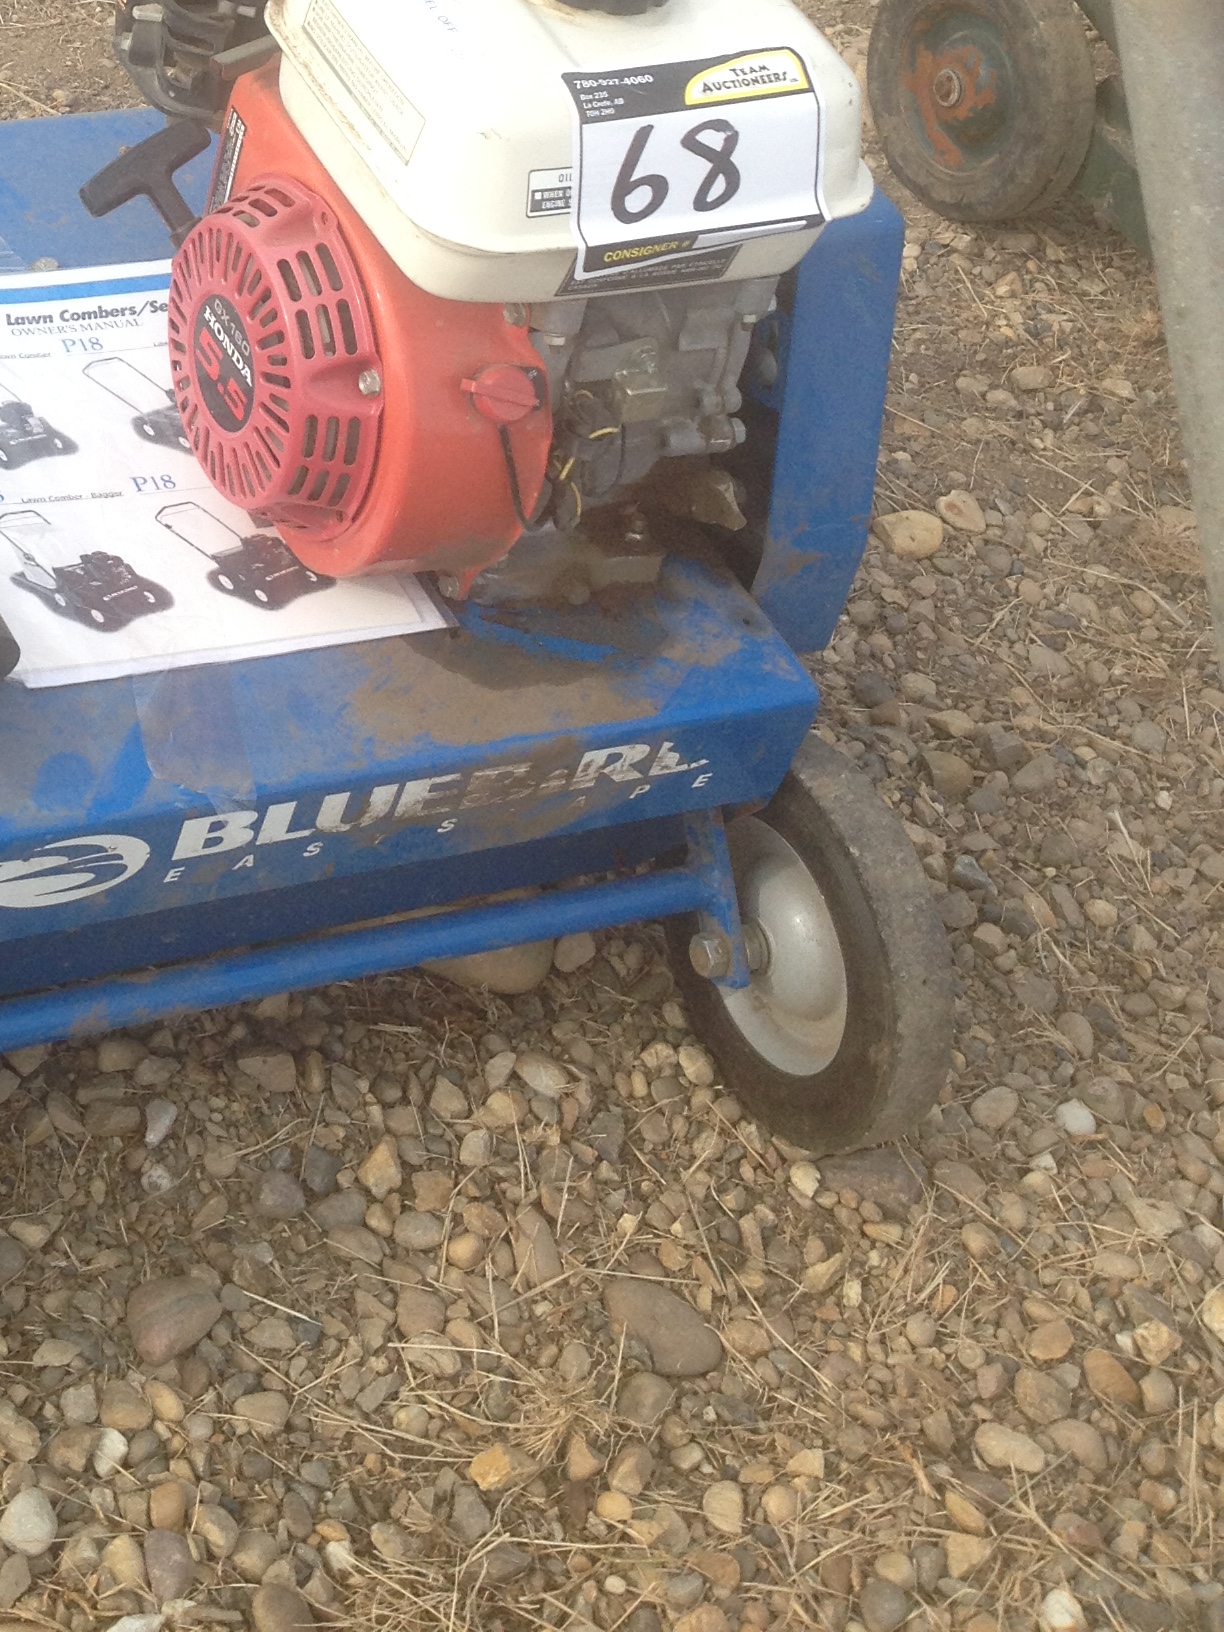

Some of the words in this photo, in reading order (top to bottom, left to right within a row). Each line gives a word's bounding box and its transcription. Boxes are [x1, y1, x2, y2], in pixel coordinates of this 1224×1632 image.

[729, 65, 770, 77] TEAM
[702, 71, 788, 93] AUCTIONEERS
[611, 119, 741, 225] 68
[603, 240, 678, 262] CONSIGNER
[6, 313, 54, 326] Lawn
[11, 324, 77, 337] OWNER'S
[81, 318, 144, 332] MANUAL
[62, 336, 104, 353] P18
[203, 305, 253, 387] HONDA
[195, 326, 248, 421] 5.5
[131, 474, 177, 492] P18
